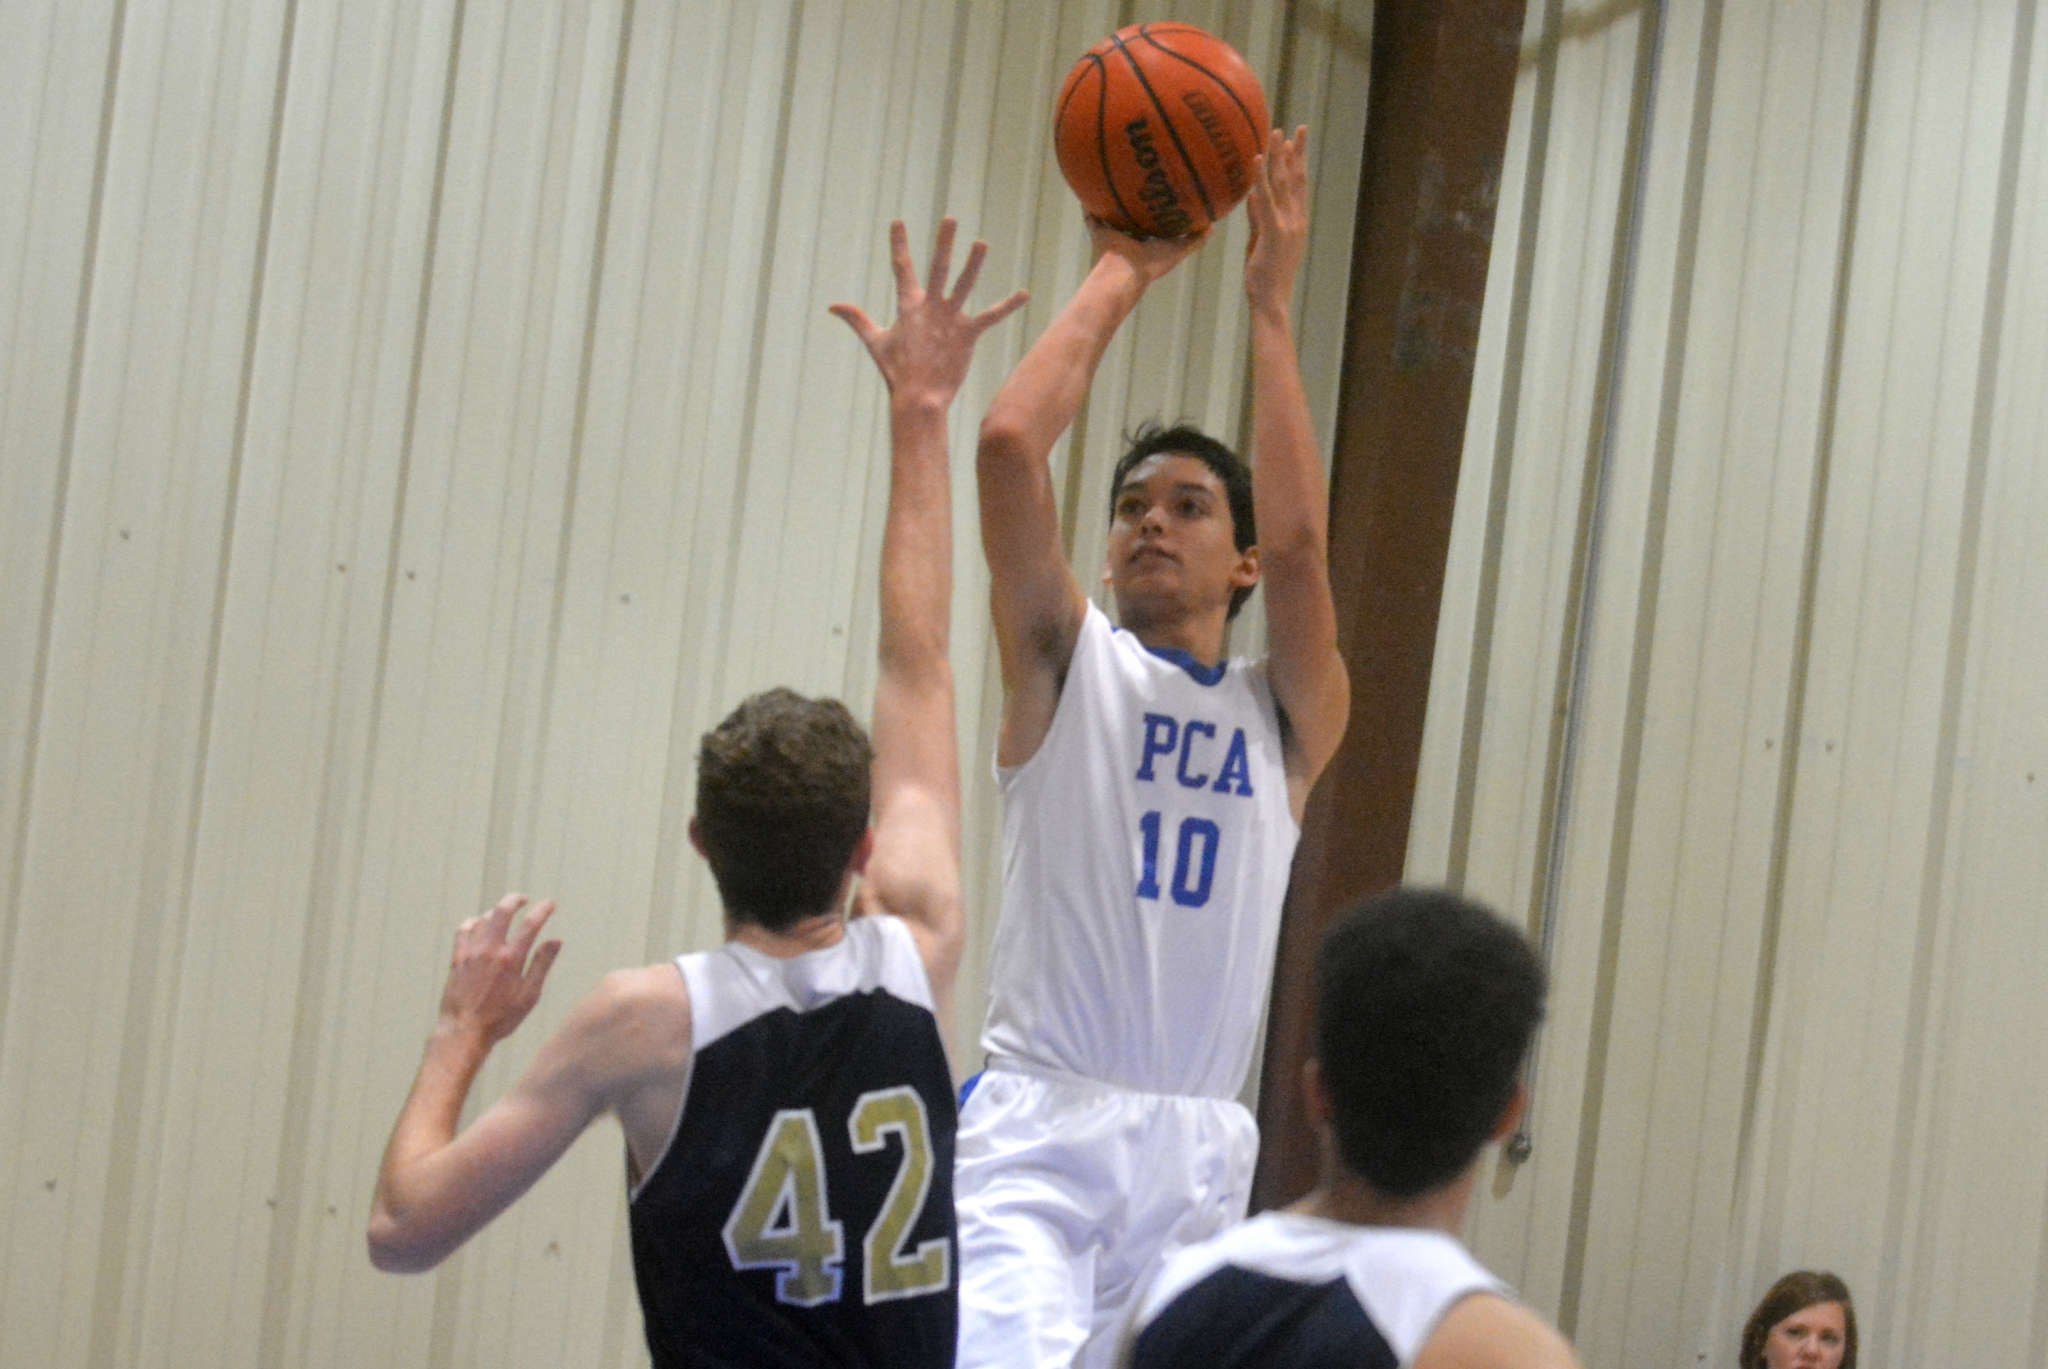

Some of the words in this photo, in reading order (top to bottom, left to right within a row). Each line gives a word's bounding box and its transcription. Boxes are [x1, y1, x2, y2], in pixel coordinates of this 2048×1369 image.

[1135, 712, 1254, 798] PCA
[1137, 810, 1220, 908] 10
[720, 1084, 950, 1307] 42
